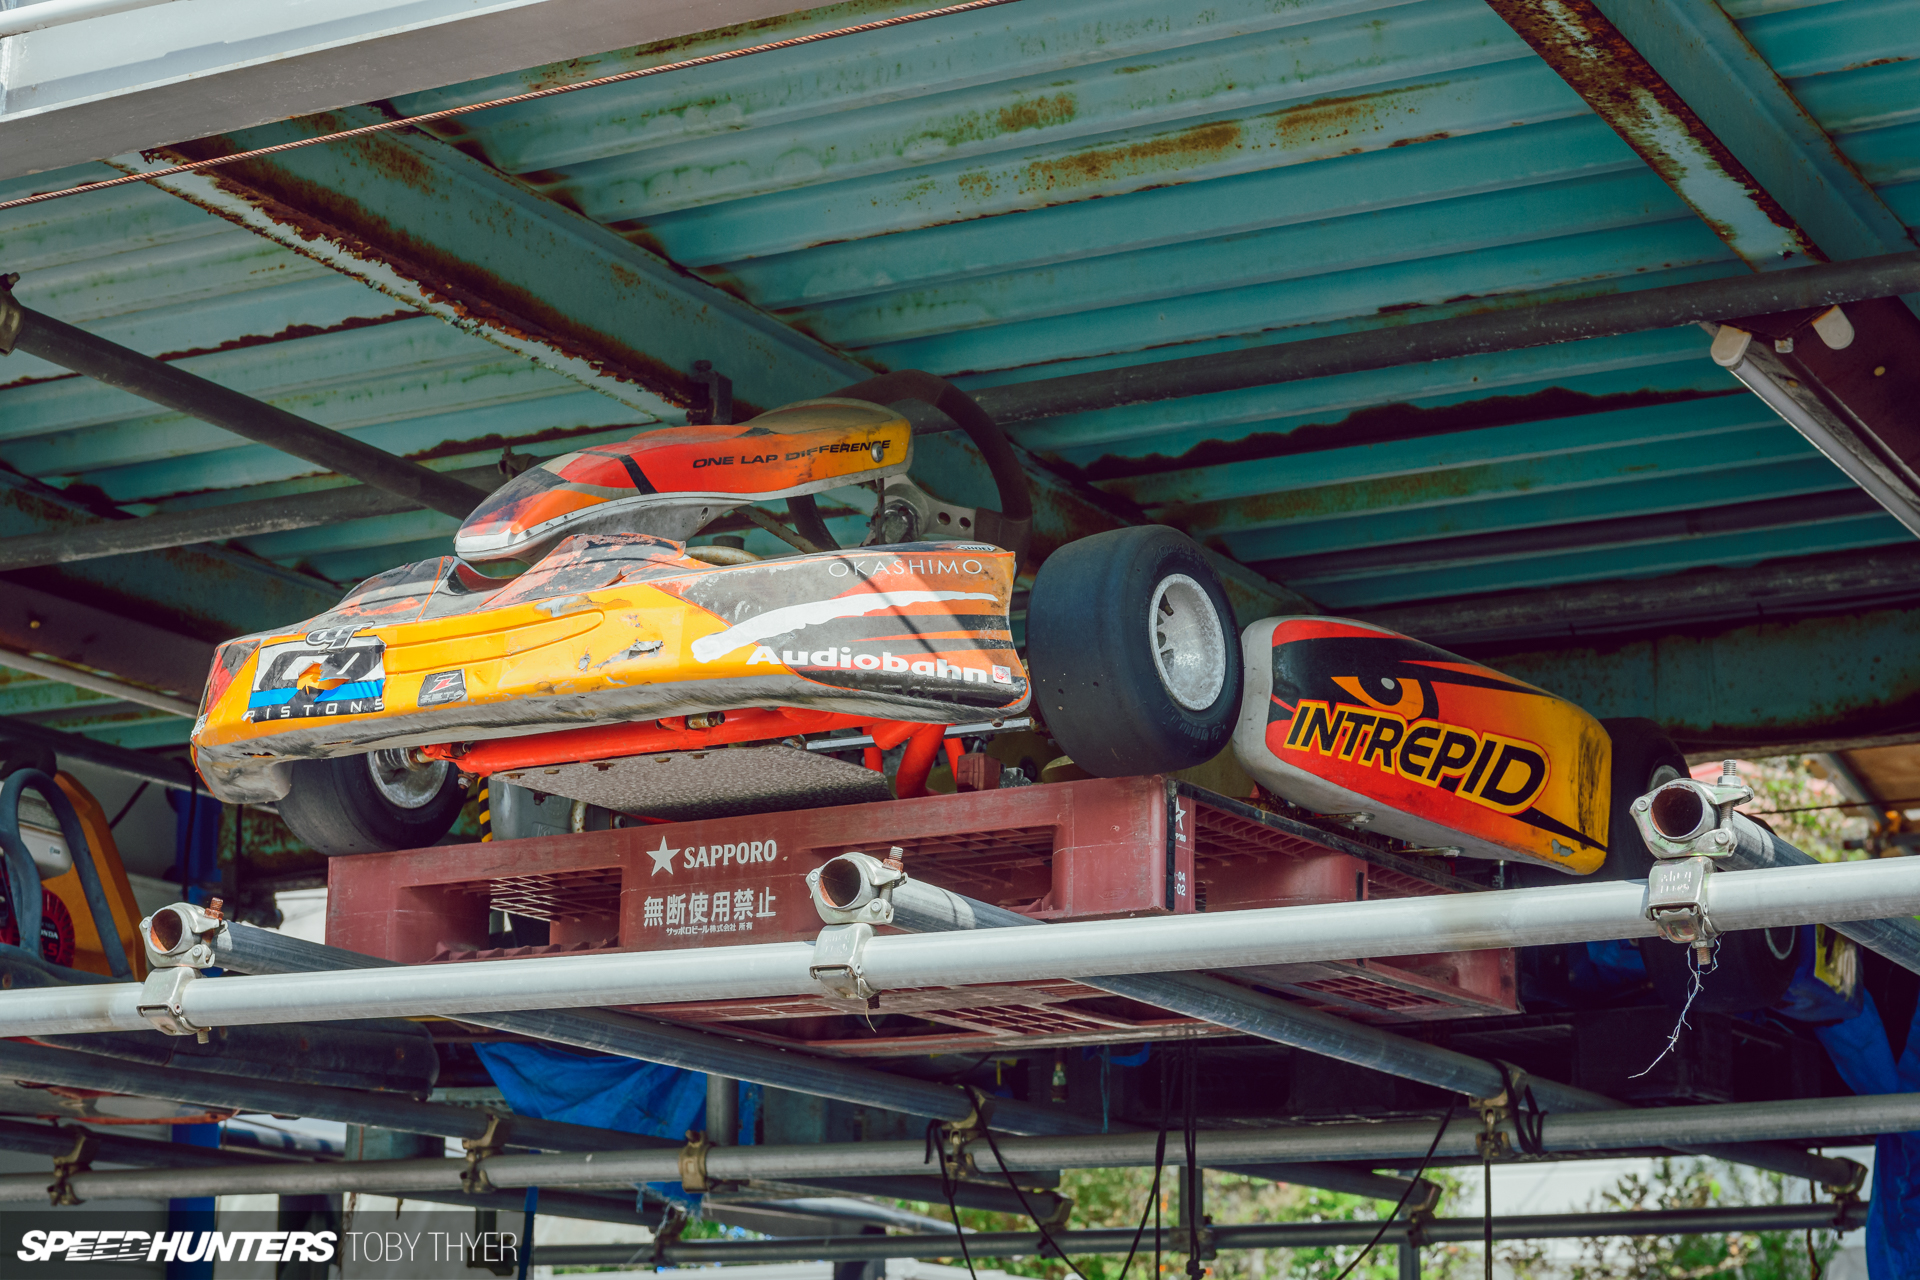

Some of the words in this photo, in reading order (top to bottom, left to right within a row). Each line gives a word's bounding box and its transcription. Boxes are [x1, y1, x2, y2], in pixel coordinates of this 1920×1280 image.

[692, 456, 735, 469] ONE
[740, 454, 779, 465] LAP
[828, 559, 983, 578] OKASHIMO
[746, 646, 988, 683] Audiobahn
[1287, 704, 1546, 807] INTREPID
[684, 840, 777, 868] SAPPORO
[643, 887, 777, 927] 無断使用禁止
